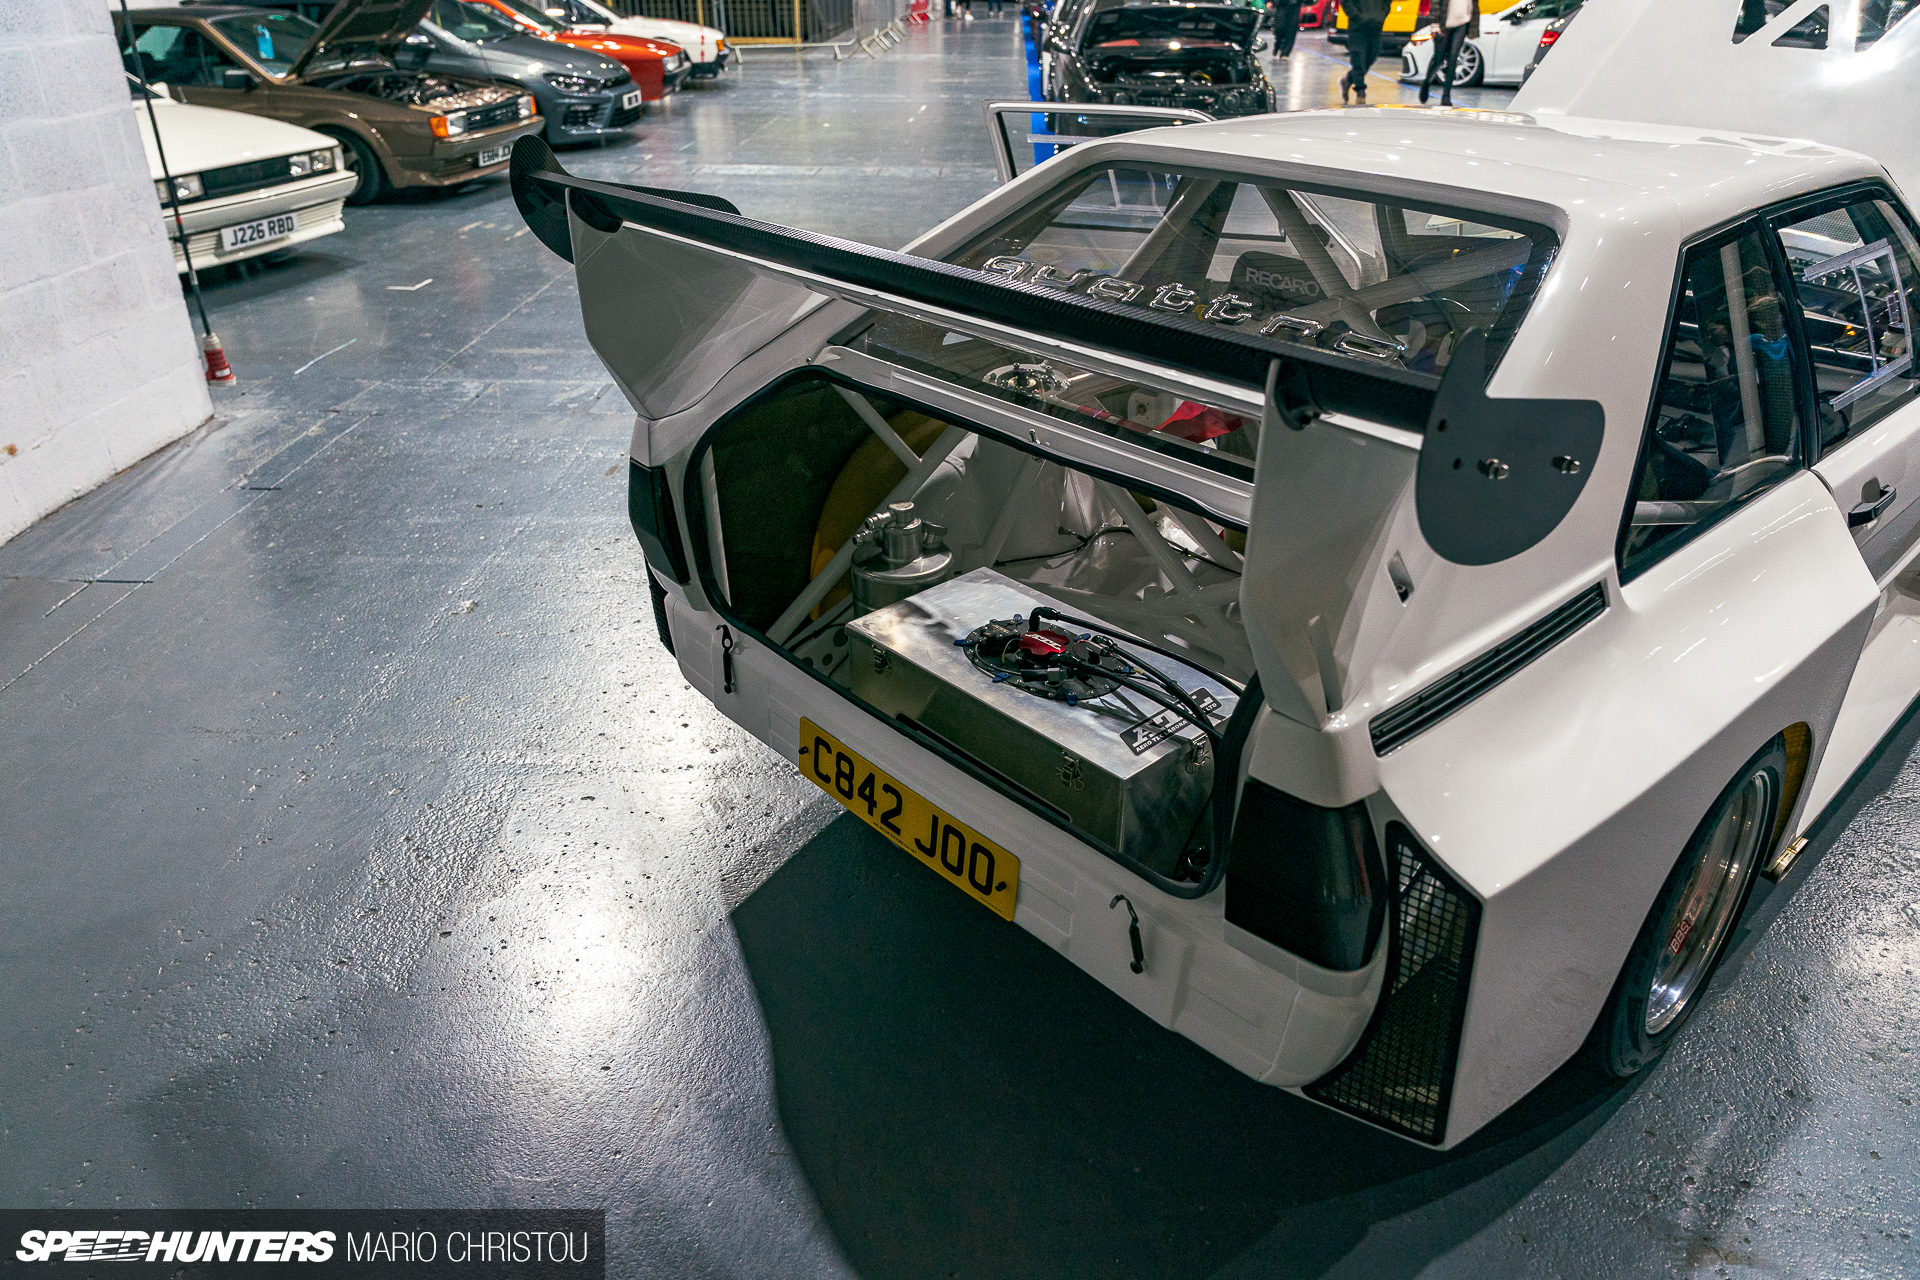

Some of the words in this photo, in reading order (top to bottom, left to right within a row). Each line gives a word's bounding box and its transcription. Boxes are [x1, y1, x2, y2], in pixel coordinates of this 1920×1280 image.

[230, 222, 265, 246] J226
[267, 216, 295, 236] RBD
[1246, 266, 1320, 297] RECARO
[981, 255, 1406, 363] quattro
[1136, 740, 1152, 753] AERO
[1205, 702, 1218, 711] LTD
[813, 736, 903, 836] C842
[1670, 920, 1692, 953] BBS
